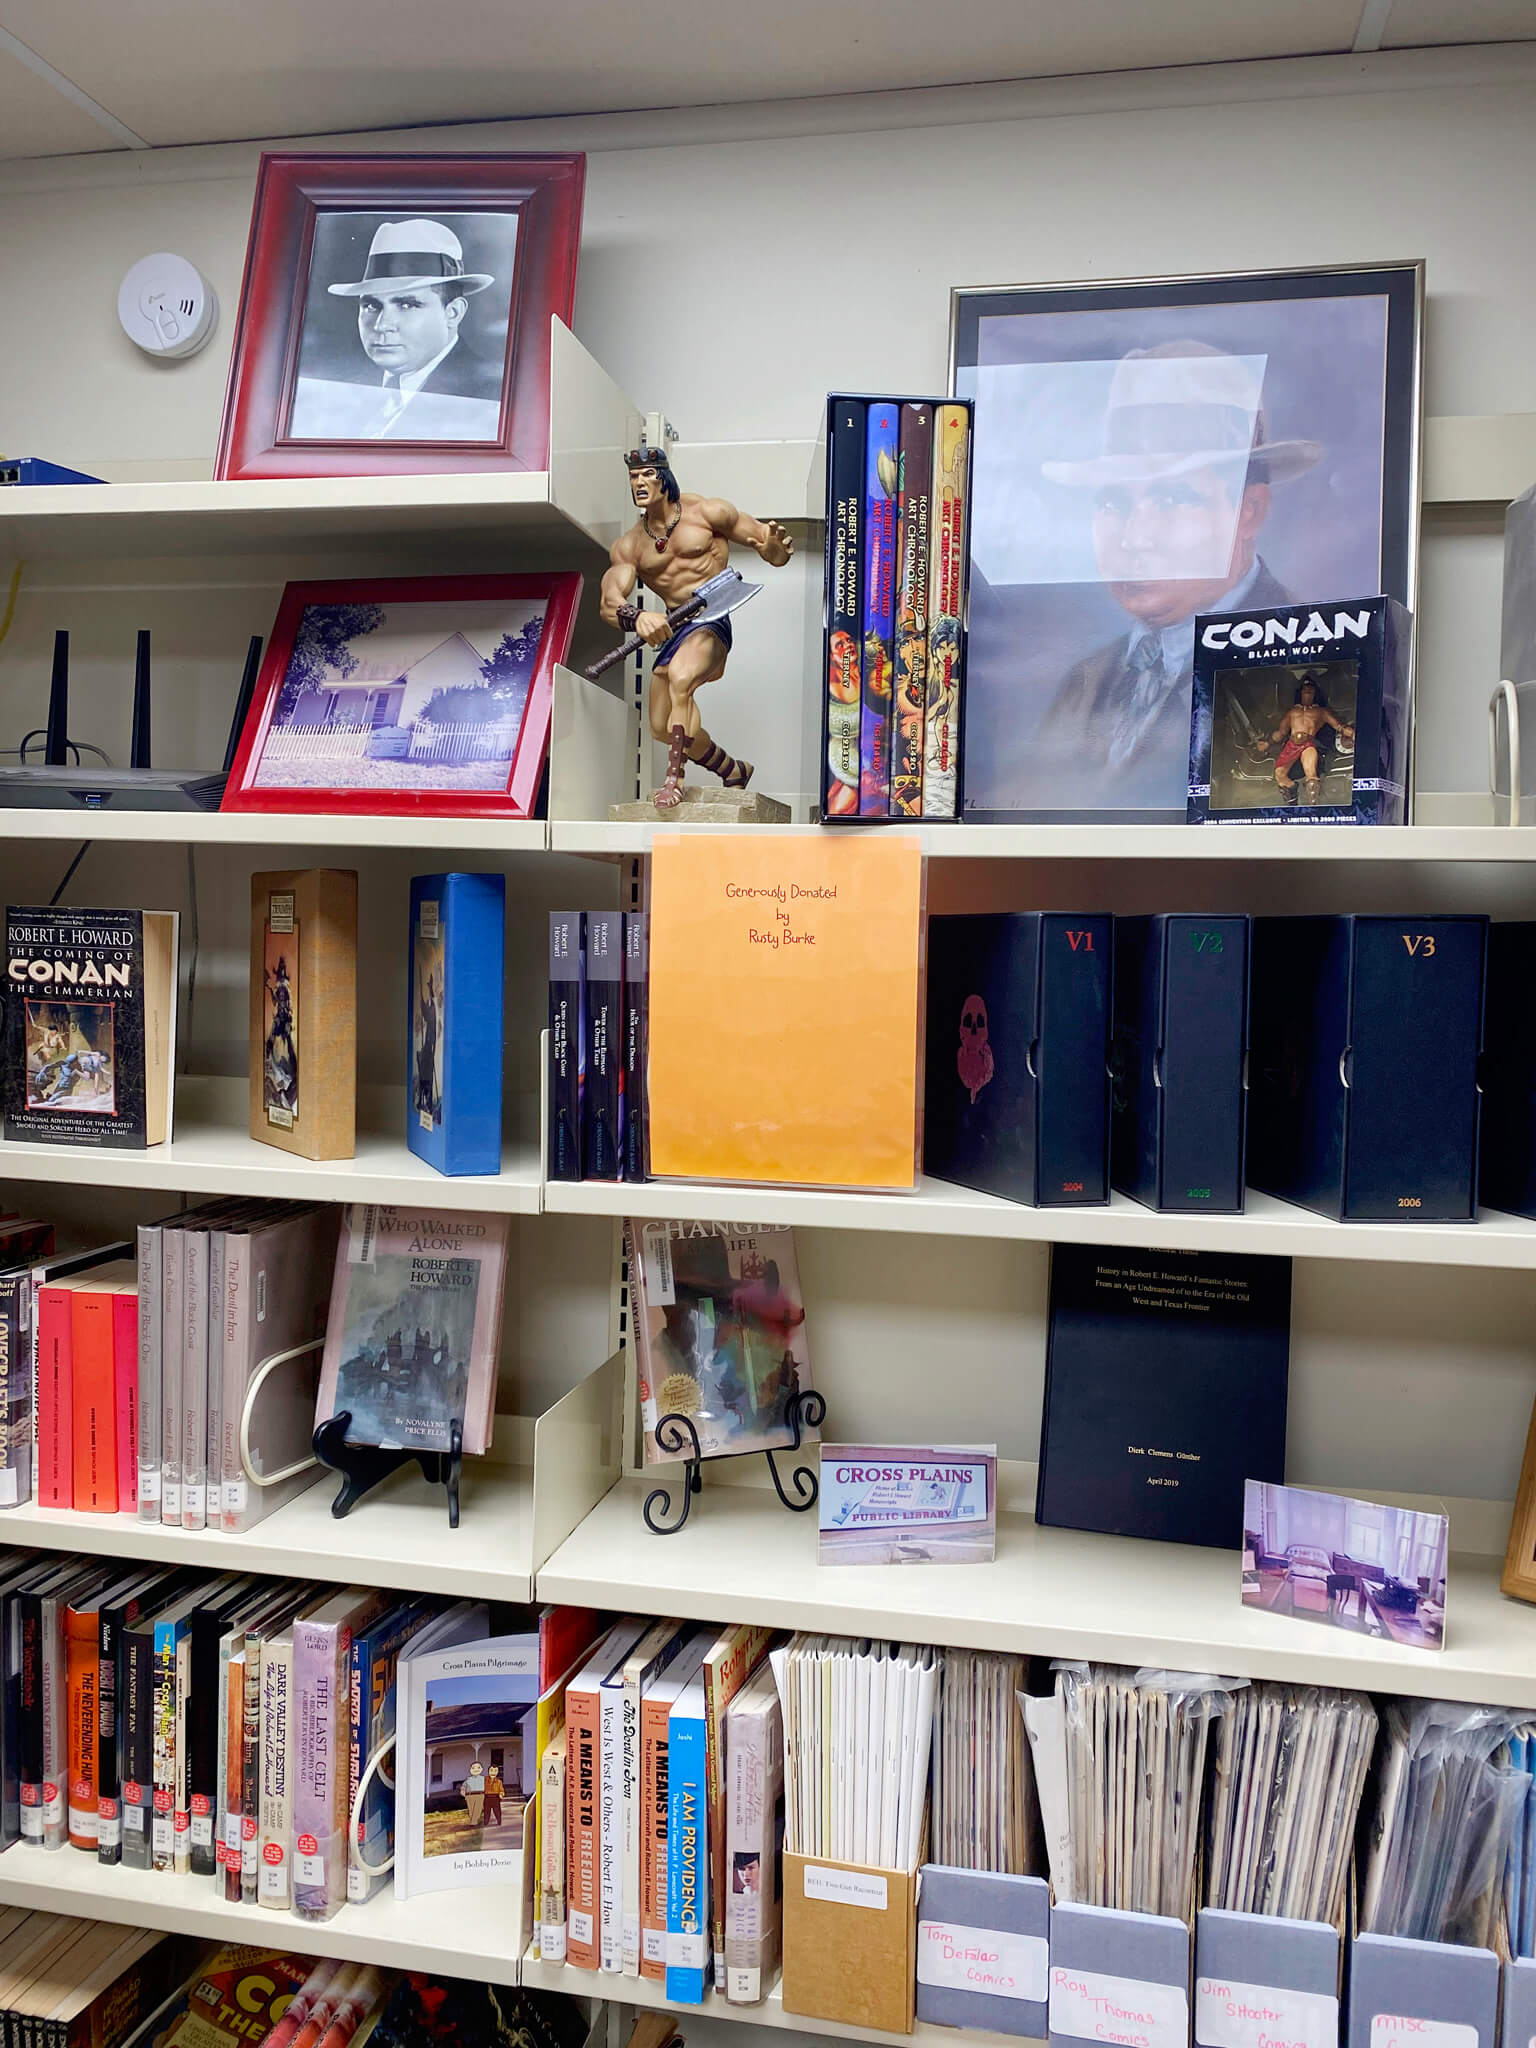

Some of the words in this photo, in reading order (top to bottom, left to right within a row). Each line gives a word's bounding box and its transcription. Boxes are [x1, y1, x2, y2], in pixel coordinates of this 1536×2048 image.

[847, 418, 854, 427] 1
[918, 416, 926, 425] 3
[950, 418, 958, 428] 4
[838, 500, 846, 522] ART
[908, 497, 917, 521] ART
[918, 495, 928, 542] ROBERT
[942, 500, 951, 523] ART
[952, 497, 962, 544] ROBERT
[848, 497, 857, 545] ROBERT
[848, 548, 856, 557] E.
[918, 545, 927, 554] E.
[836, 527, 846, 613] CHRONOLOGY
[906, 525, 917, 611] CHRONOLOGY
[940, 526, 951, 614] CHRONOLOGY
[847, 560, 857, 617] HOWARD
[917, 558, 927, 614] HOWARD
[950, 560, 961, 617] HOWARD
[1201, 610, 1371, 650] CONAN
[1248, 648, 1287, 660] BLACK
[1292, 644, 1325, 656] WOLF
[842, 740, 850, 771] 21420
[725, 882, 787, 903] Generously
[790, 883, 837, 899] Donated
[776, 907, 790, 926] by
[8, 926, 56, 943] ROBERT
[60, 928, 68, 943] E.
[72, 929, 134, 946] HOWARD
[561, 924, 569, 950] Robert
[749, 928, 779, 949] Rusty
[783, 928, 816, 945] Burke
[1064, 930, 1096, 952] V1
[1190, 931, 1225, 953] V2
[1402, 935, 1436, 957] V3
[9, 947, 35, 957] THE
[43, 948, 105, 960] COMING
[113, 951, 134, 961] OF
[8, 958, 131, 987] CONAN
[9, 983, 35, 994] THE
[44, 985, 133, 999] CIMMERIAN
[1063, 1181, 1084, 1192] 2004
[1398, 1197, 1422, 1208] 2006
[379, 1217, 420, 1233] WHO
[419, 1219, 487, 1237] WALKED
[408, 1235, 464, 1253] ALONE
[228, 1259, 239, 1279] The
[412, 1258, 461, 1272] ROBERT
[1096, 1266, 1121, 1276] History
[1121, 1268, 1129, 1276] in
[1129, 1269, 1152, 1279] Robert
[1161, 1272, 1193, 1283] Howard's
[1194, 1275, 1223, 1286] Fantastic
[410, 1271, 473, 1286] HOWARD
[1095, 1279, 1113, 1289] From
[1123, 1282, 1137, 1292] Age
[1138, 1283, 1175, 1294] Undreamed
[1175, 1287, 1185, 1295] of
[1192, 1288, 1203, 1297] the
[1204, 1290, 1216, 1298] Era
[1216, 1291, 1225, 1299] of
[1225, 1292, 1236, 1300] the
[1237, 1293, 1250, 1302] Old
[1132, 1296, 1150, 1305] West
[1150, 1298, 1163, 1307] and
[1164, 1299, 1183, 1309] Texas
[1184, 1301, 1210, 1311] Frontier
[226, 1320, 237, 1342] Iron
[1128, 1446, 1145, 1456] Dierk
[1147, 1448, 1174, 1459] Clemens
[835, 1467, 904, 1484] CROSS
[909, 1468, 973, 1484] PLAINS
[1147, 1476, 1163, 1487] April
[1163, 1477, 1179, 1488] 2019
[852, 1511, 899, 1522] PUBLIC
[902, 1510, 952, 1520] LIBRARY
[103, 1623, 111, 1651] Nielsen
[306, 1642, 328, 1651] LORD
[99, 1659, 115, 1690] ROBERT
[266, 1661, 275, 1679] The
[442, 1661, 463, 1671] Cross
[464, 1659, 486, 1669] Plains
[487, 1657, 528, 1670] Pilgrimage
[82, 1671, 94, 1691] THE
[264, 1680, 275, 1699] Life
[277, 1663, 287, 1697] DARK
[317, 1676, 328, 1709] THE
[264, 1700, 274, 1710] of
[623, 1699, 637, 1724] The
[81, 1692, 94, 1761] NEVERENDING
[99, 1701, 114, 1738] HOWARD
[129, 1713, 137, 1733] FAN
[264, 1711, 274, 1744] Robert
[276, 1700, 286, 1745] VALLEY
[603, 1705, 615, 1734] West
[316, 1716, 328, 1756] LAST
[580, 1727, 593, 1741] A
[603, 1738, 614, 1747] Is
[623, 1726, 637, 1755] Devil
[677, 1732, 693, 1742] Joshi
[656, 1740, 668, 1752] A
[275, 1747, 286, 1798] DESTINY
[579, 1743, 593, 1801] MEANS
[603, 1751, 614, 1780] West
[624, 1756, 635, 1767] in
[81, 1762, 93, 1787] HUN
[263, 1754, 274, 1798] Howard
[314, 1761, 327, 1802] CELT
[623, 1769, 637, 1799] Iron
[655, 1756, 669, 1814] MEANS
[603, 1782, 613, 1792] &
[579, 1804, 593, 1827] TO
[602, 1795, 614, 1833] Others
[683, 1791, 696, 1821] AM
[655, 1817, 668, 1840] TO
[453, 1860, 463, 1870] by
[464, 1858, 490, 1870] Bobby
[580, 1829, 593, 1907] FREEDOM
[602, 1844, 614, 1880] Robert
[603, 1884, 613, 1895] E.
[656, 1843, 668, 1921] FREEDOM
[681, 1825, 697, 1932] PROVIDENCE
[603, 1899, 614, 1927] How
[922, 1925, 953, 1943] Tom
[967, 1967, 1016, 1988] Comics
[1055, 1971, 1088, 1998] Roy
[1201, 1980, 1232, 1998] Jim
[217, 2003, 267, 2041] THE
[1087, 1997, 1156, 2026] Thomas
[1095, 2023, 1151, 2048] Comics
